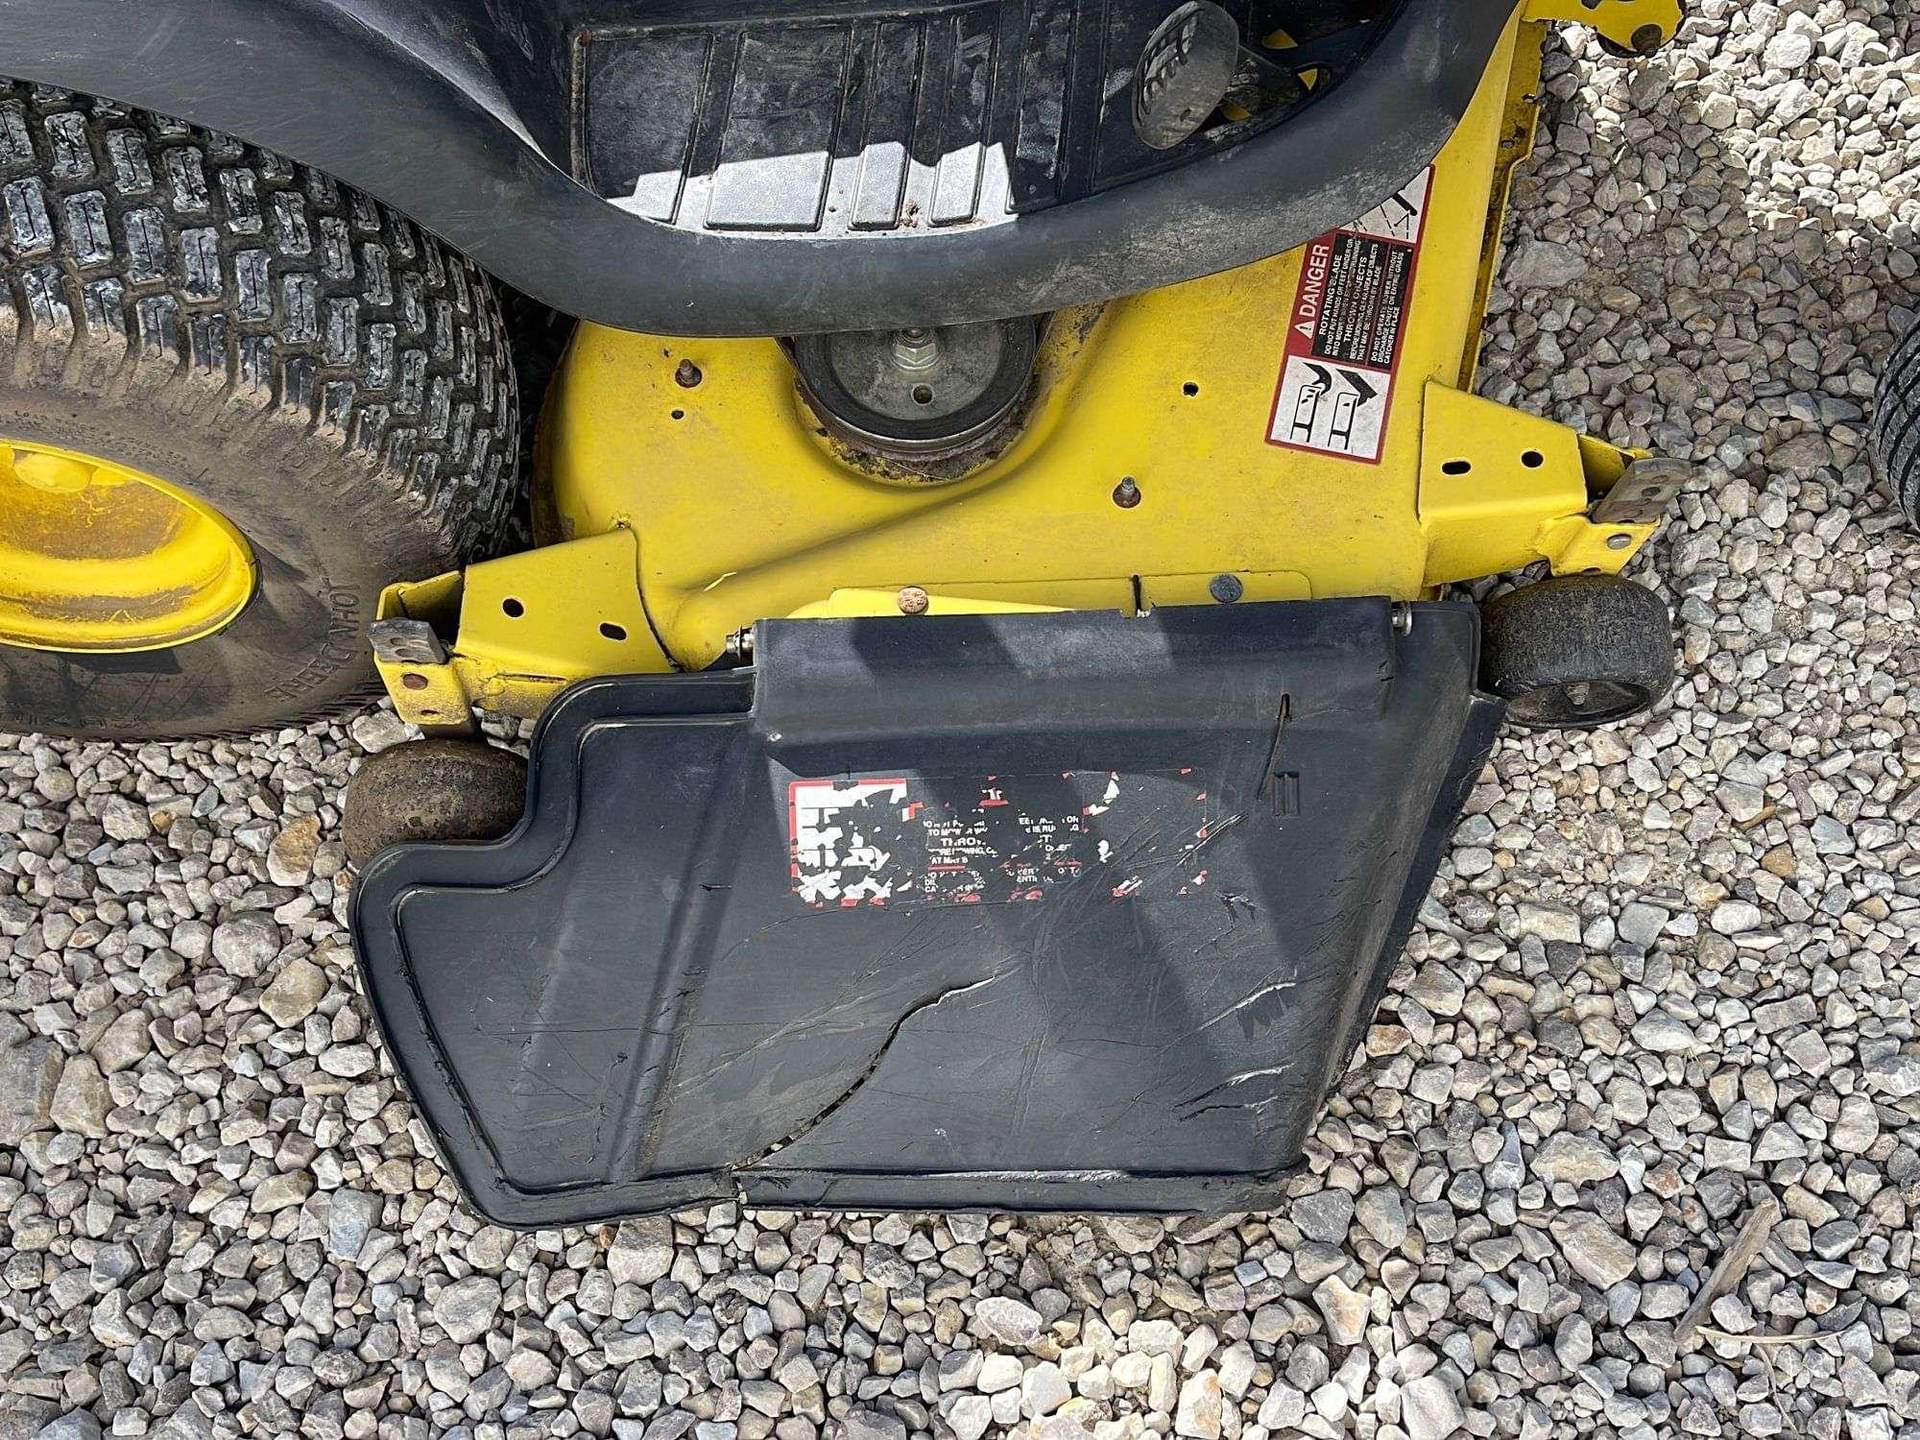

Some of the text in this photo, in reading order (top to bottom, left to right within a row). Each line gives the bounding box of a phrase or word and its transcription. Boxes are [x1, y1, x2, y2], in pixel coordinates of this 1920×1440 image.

[1342, 249, 1352, 270] UNDER
[1299, 244, 1329, 317] DANGER
[1339, 271, 1347, 285] FEET
[1319, 255, 1342, 335] ROTATING BLADE
[1337, 286, 1344, 296] OR
[1332, 297, 1342, 317] HANDS
[1329, 318, 1337, 330] PUT
[1343, 301, 1358, 343] THROWN
[1326, 331, 1335, 344] NOT
[1361, 331, 1369, 344] MAY
[1384, 335, 1394, 363] CATCHER
[1391, 306, 1400, 327] PLACE
[1324, 345, 1332, 354] DO
[1332, 341, 1340, 356] INTO
[1373, 337, 1381, 350] NOT
[1357, 345, 1366, 360] THAT
[1371, 351, 1378, 361] DO
[318, 576, 360, 641] JOHN
